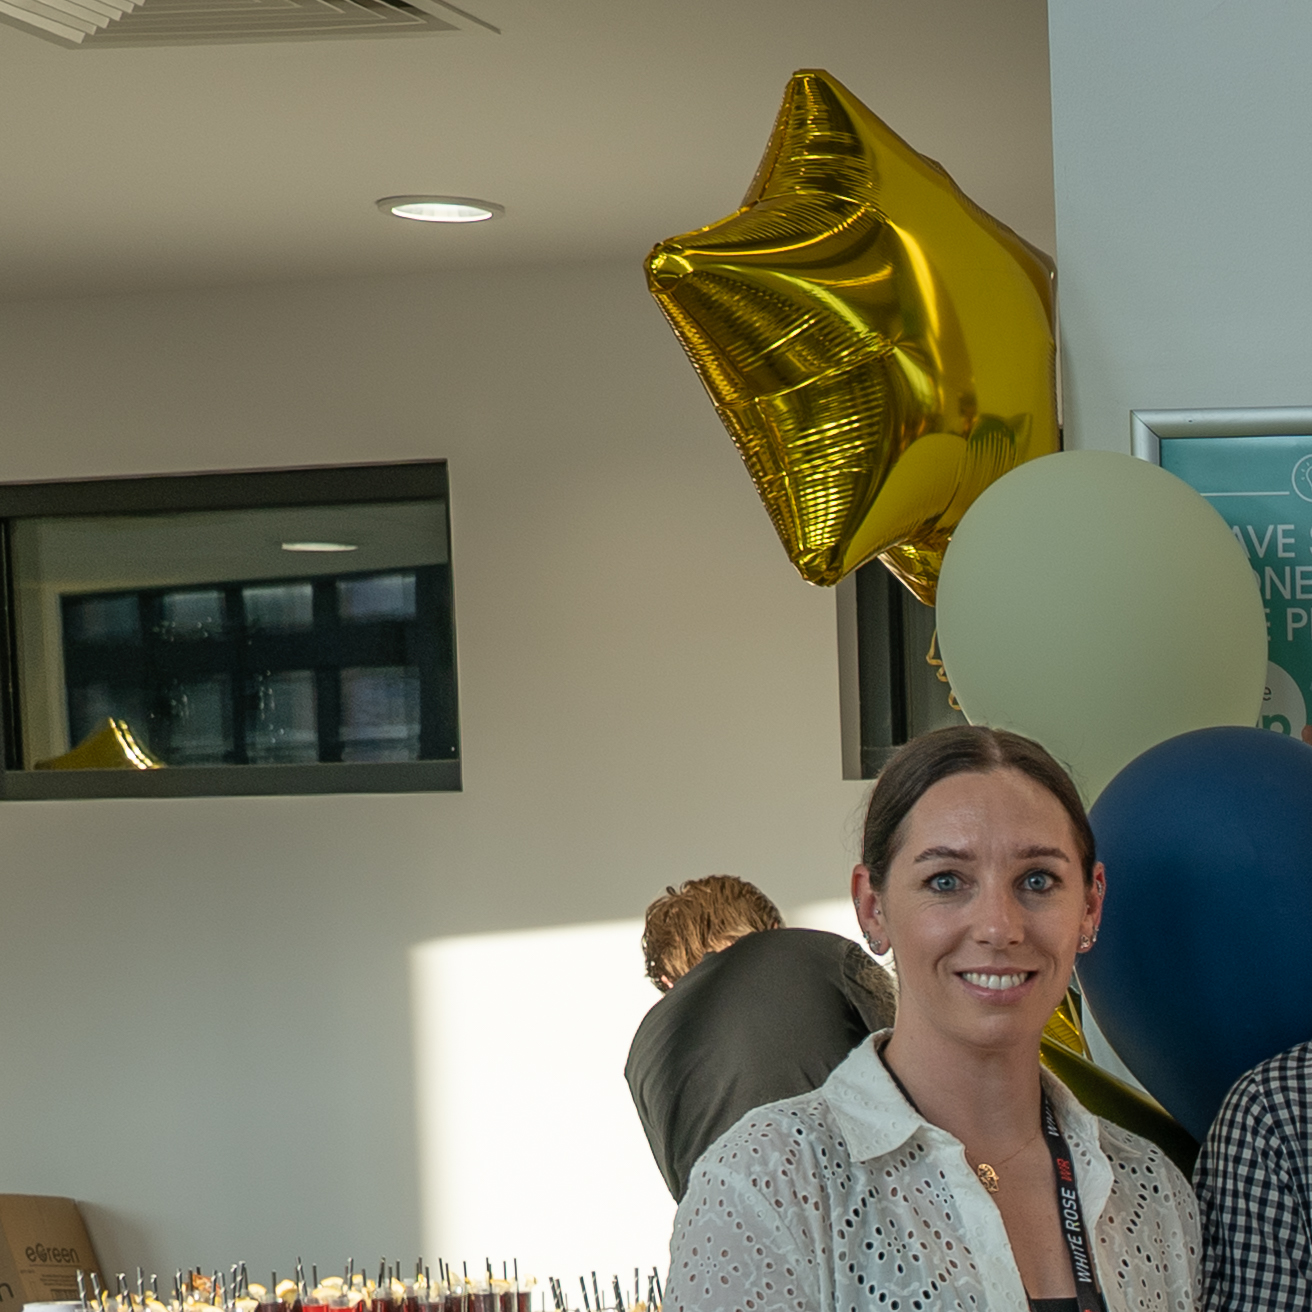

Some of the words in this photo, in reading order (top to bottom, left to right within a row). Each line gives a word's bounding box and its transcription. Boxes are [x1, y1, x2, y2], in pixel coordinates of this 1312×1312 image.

[1231, 524, 1297, 560] AVE
[1056, 1158, 1073, 1182] WR
[1061, 1187, 1082, 1232] ROSE
[1067, 1233, 1093, 1284] WHITE
